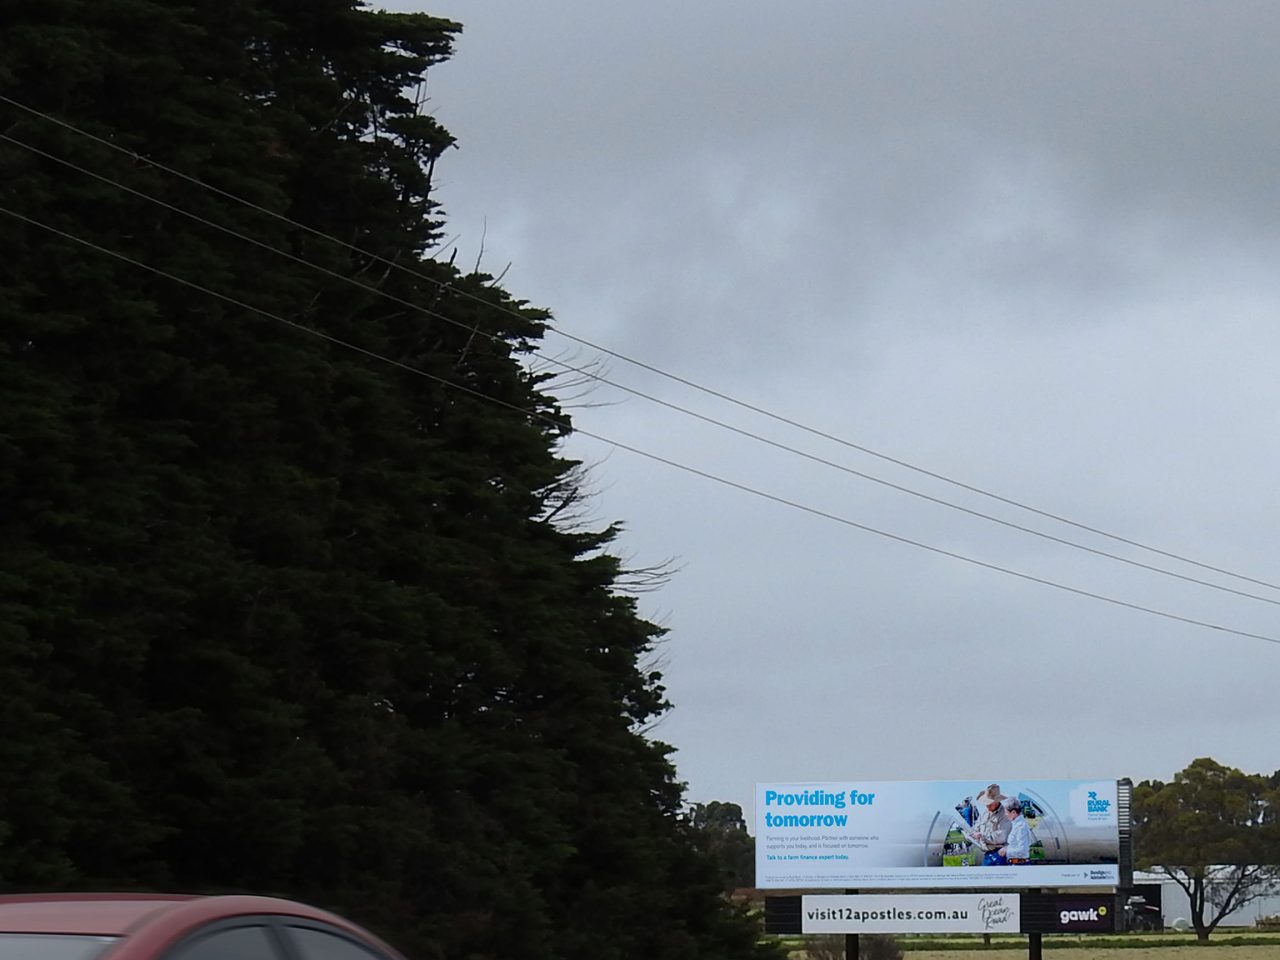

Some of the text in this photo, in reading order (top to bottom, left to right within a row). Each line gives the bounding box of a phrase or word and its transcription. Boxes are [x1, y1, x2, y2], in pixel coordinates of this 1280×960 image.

[765, 790, 875, 809] Providing for
[765, 812, 848, 827] tomorrow
[977, 896, 1003, 911] Great
[807, 907, 969, 923] visit12apostles.com.au
[1060, 908, 1099, 924] gawk
